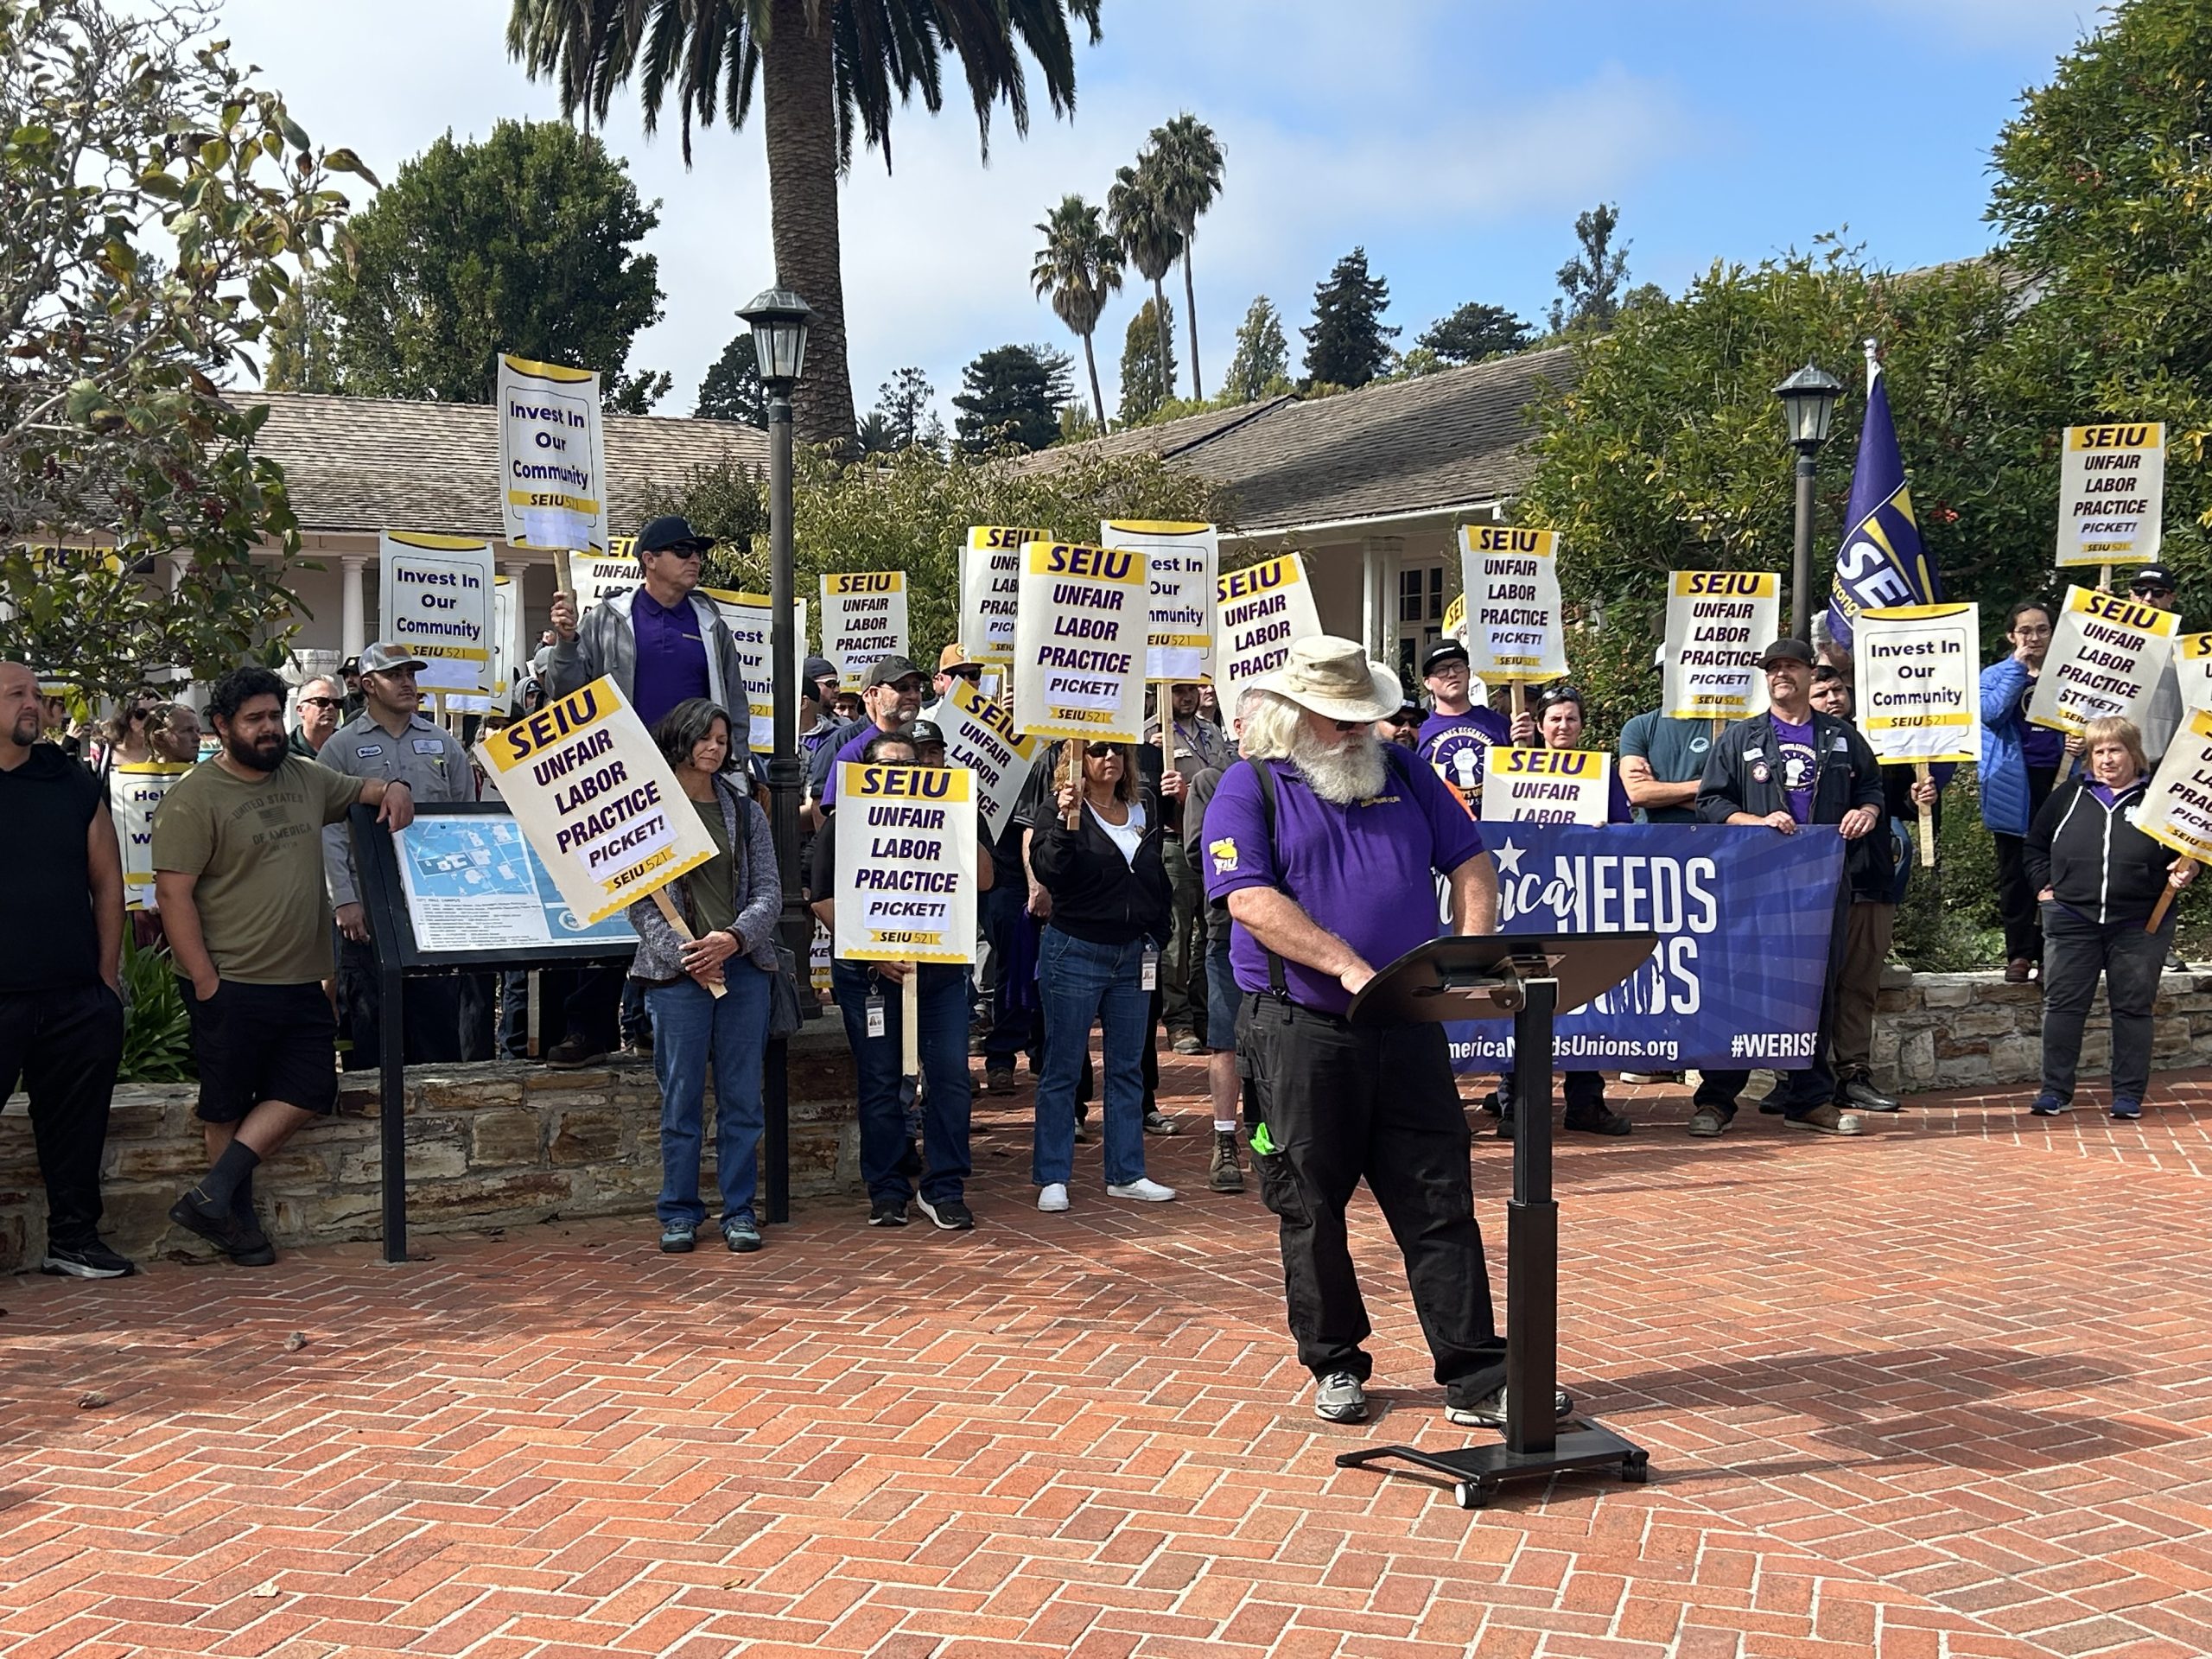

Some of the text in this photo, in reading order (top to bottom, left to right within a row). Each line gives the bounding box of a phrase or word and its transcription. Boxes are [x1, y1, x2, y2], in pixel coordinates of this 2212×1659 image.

[511, 400, 585, 429] Invest In
[535, 431, 566, 452] Our
[2082, 427, 2147, 448] SEIU
[2084, 454, 2141, 471] UNFAIR
[513, 460, 588, 491] Community
[2085, 477, 2138, 493] LABOR
[531, 493, 564, 506] SEIU
[2074, 499, 2148, 517] PRACTICE
[2082, 522, 2138, 534] PICKET!
[1479, 529, 1539, 552] SEIU
[2088, 543, 2110, 552] SEIU
[1047, 545, 1132, 578] SEIU
[1151, 558, 1203, 572] est In
[1484, 559, 1537, 576] UNFAIR
[397, 568, 480, 588] Invest In
[837, 575, 891, 593] SEIU
[991, 578, 1019, 593] LAB
[1217, 562, 1281, 603] SEIU
[1688, 573, 1760, 594] SEIU
[1837, 541, 1915, 610] SE
[1053, 584, 1124, 611] UNFAIR
[1150, 581, 1180, 595] Our
[1488, 584, 1536, 601] LABOR
[421, 594, 456, 609] Our
[842, 598, 889, 612] UNFAIR
[980, 600, 1018, 615] PRAC
[1225, 594, 1287, 627] UNFAIR
[1693, 602, 1754, 619] UNFAIR
[1148, 606, 1204, 627] mmunity
[1448, 598, 1463, 626] SEI
[1480, 608, 1548, 626] PRACTICE
[2084, 595, 2159, 629] SEIU
[397, 617, 480, 641] Community
[845, 617, 887, 632] LABOR
[1054, 616, 1119, 641] LABOR
[1694, 626, 1750, 643] LABOR
[734, 630, 764, 644] est
[836, 636, 898, 651] PRACTICE
[1147, 635, 1192, 645] EIU 521
[1235, 620, 1291, 652] LABOR
[1491, 632, 1542, 645] PICKET!
[2083, 622, 2145, 652] UNFAIR
[412, 645, 466, 658] SEIU 521
[845, 654, 892, 664] PICKET
[1680, 651, 1762, 667] PRACTICE
[1872, 640, 1961, 658] Invest In
[1037, 645, 1132, 674] PRACTICE
[1499, 656, 1522, 665] SEIU
[2076, 645, 2135, 674] LABOR
[1689, 673, 1750, 685] PICKET!
[1897, 665, 1935, 678] Our
[2056, 664, 2142, 699] PRACTICE
[1049, 677, 1119, 696] PICKET!
[1873, 686, 1962, 706] Community
[1698, 696, 1722, 704] SEIU
[507, 689, 598, 761] SEIU
[965, 694, 1027, 747] SEIU
[1058, 709, 1106, 723] SEIU 521
[1891, 715, 1947, 728] SEIU 521
[959, 721, 1011, 768] UNFAIR
[533, 728, 613, 786] UNFAIR
[950, 744, 1001, 789] LABOR
[1507, 750, 1587, 775] SEIU
[555, 760, 628, 817] LABOR
[861, 768, 951, 798] SEIU
[1511, 782, 1580, 801] UNFAIR
[134, 790, 164, 801] Hel
[232, 792, 303, 820] UNITED STATES
[1513, 808, 1576, 824] LABOR
[556, 780, 662, 855] PRACTICE
[868, 806, 945, 830] UNFAIR
[2171, 807, 2212, 832] PICK
[252, 823, 313, 845] OF AMERICA
[588, 815, 664, 868] PICKET!
[2171, 829, 2200, 846] SEIU
[871, 838, 942, 861] LABOR
[613, 852, 668, 889] SEIU 521
[855, 869, 958, 893] PRACTICE
[1555, 855, 1718, 934] NEEDS
[869, 901, 946, 918] PICKET!
[880, 931, 933, 944] SEIU 521
